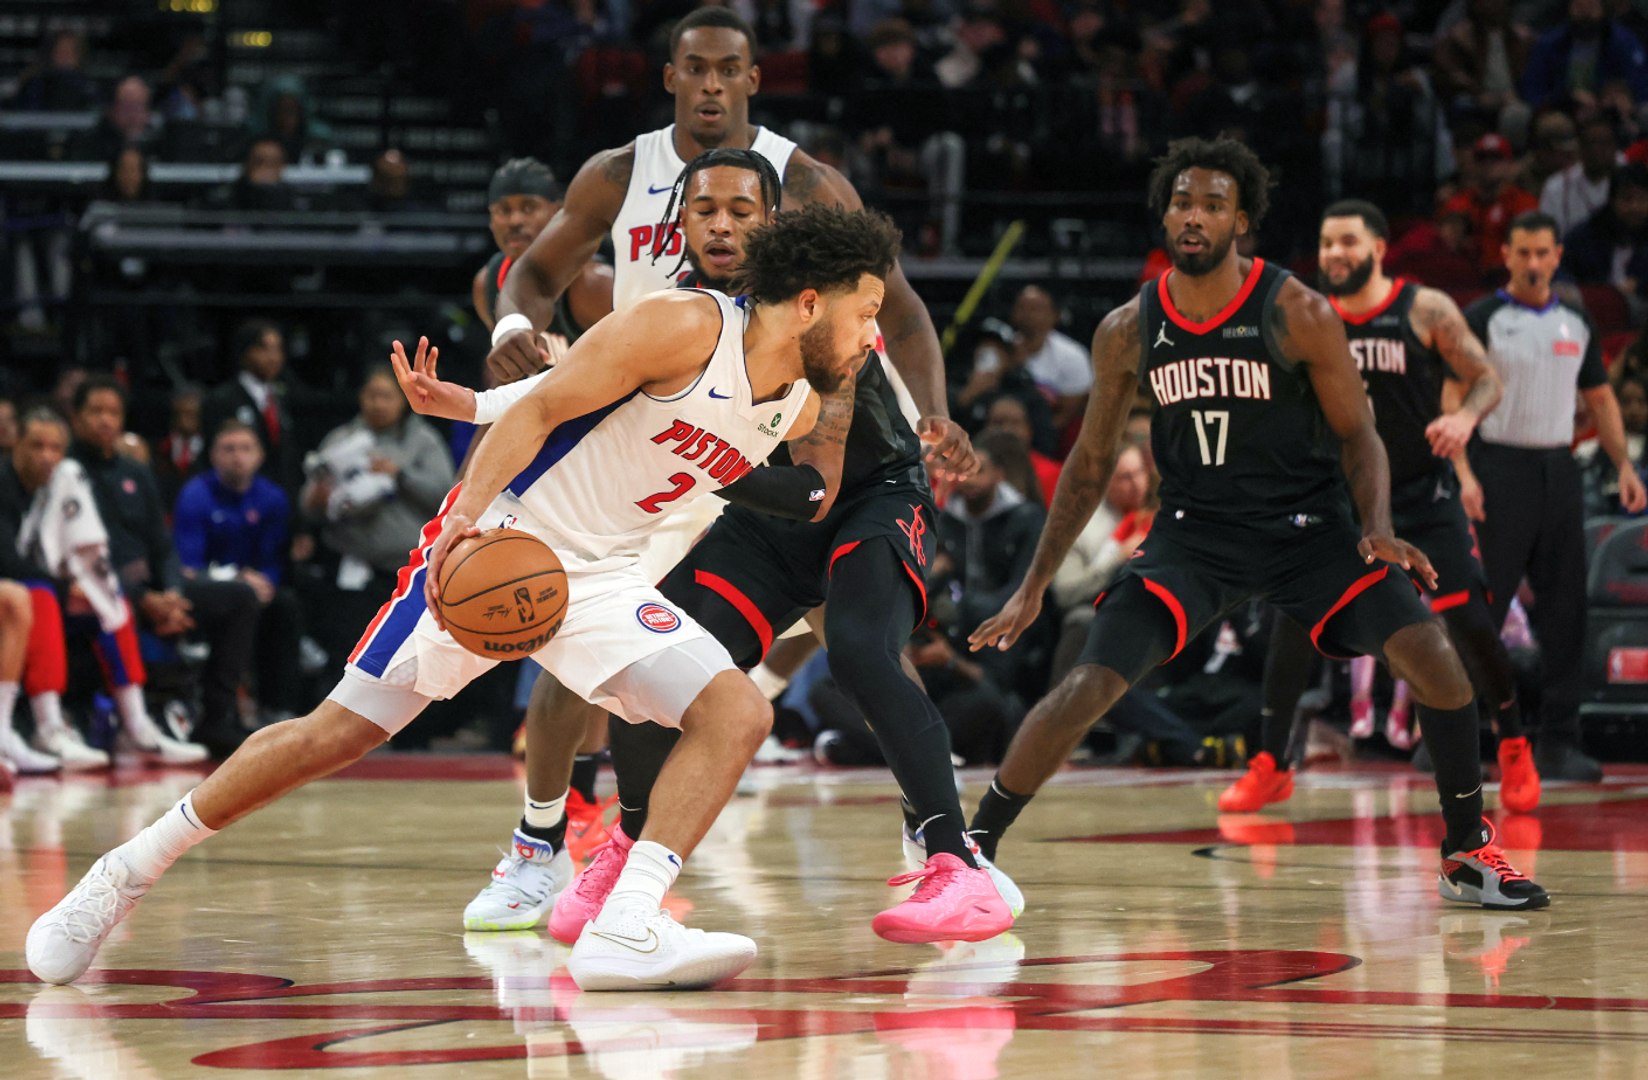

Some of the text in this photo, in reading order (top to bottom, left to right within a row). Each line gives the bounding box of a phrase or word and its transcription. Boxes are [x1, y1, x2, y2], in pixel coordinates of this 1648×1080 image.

[1149, 357, 1271, 406] HOUSTON
[1191, 410, 1229, 466] 17
[633, 472, 696, 514] 2
